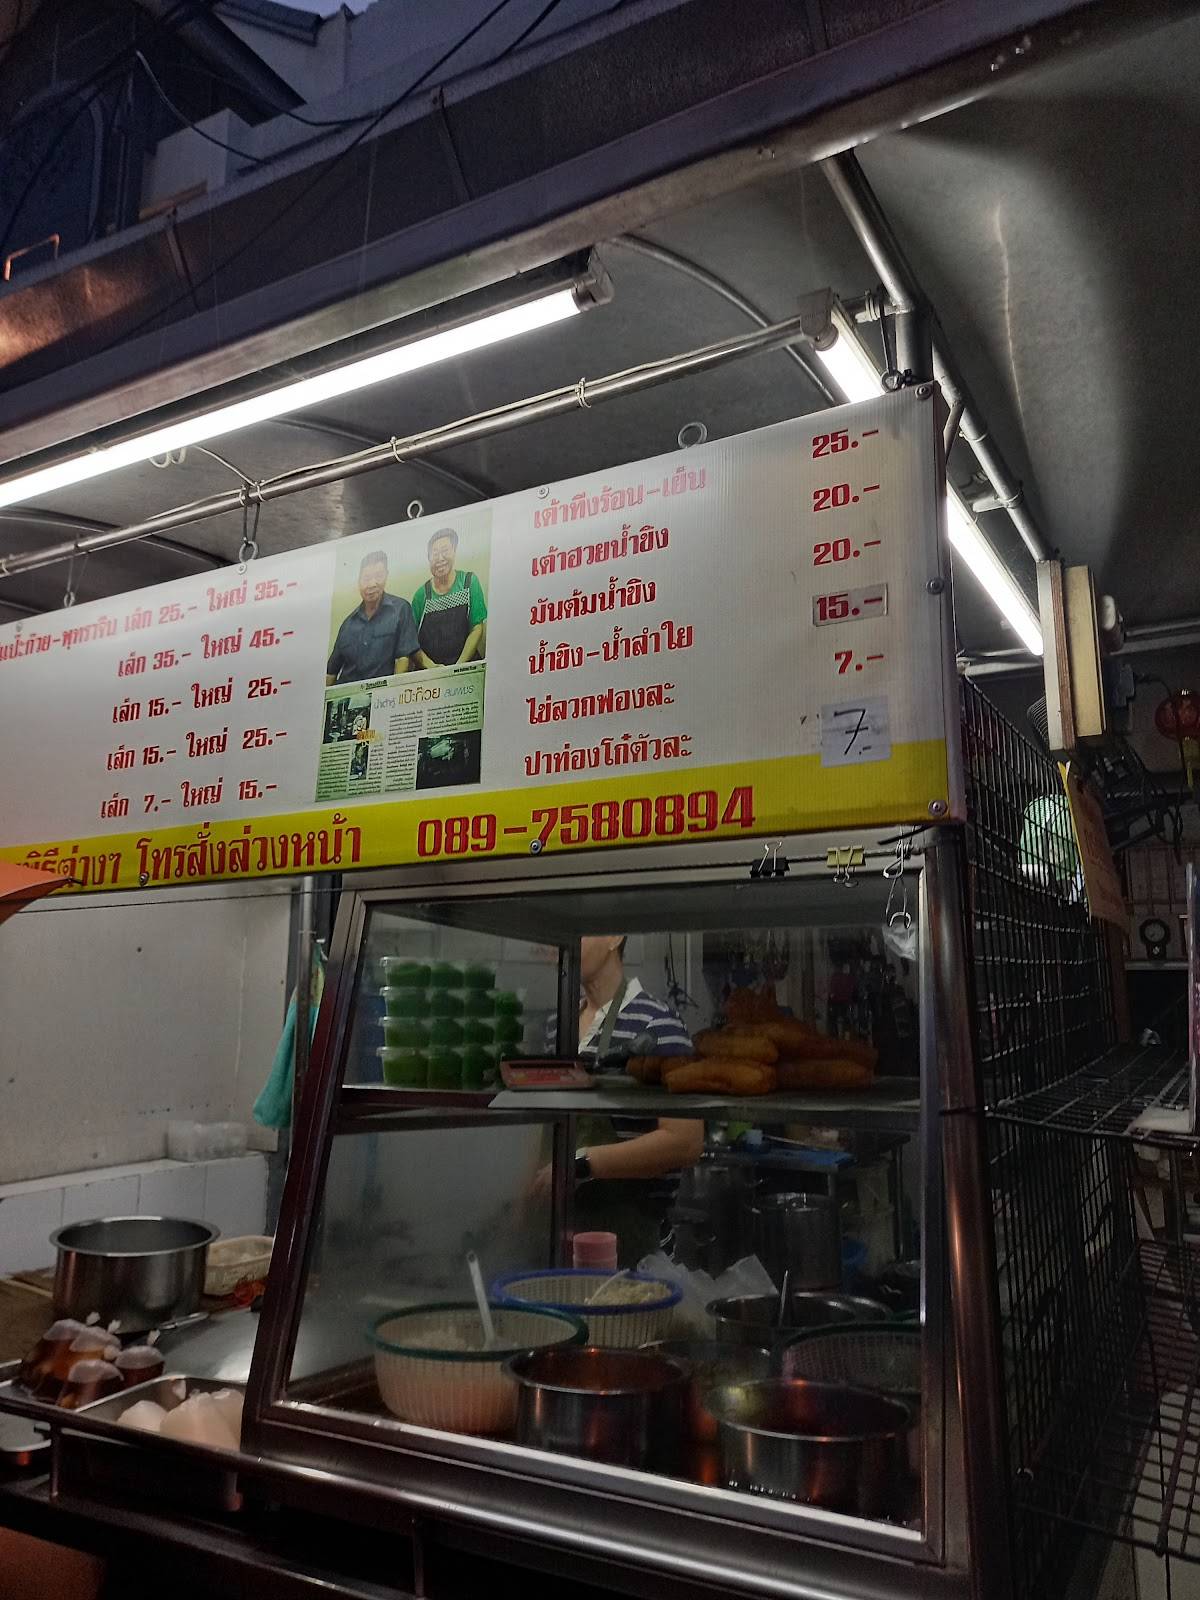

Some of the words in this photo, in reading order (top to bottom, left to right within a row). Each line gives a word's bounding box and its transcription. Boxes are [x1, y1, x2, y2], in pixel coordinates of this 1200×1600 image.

[811, 428, 880, 459] 25.-
[531, 524, 670, 577] เต้าฮวยน้ำขิง
[812, 483, 881, 512] 20.-
[529, 577, 656, 626] มันต้มน้ำขิง
[812, 538, 882, 567] 20.-
[124, 608, 152, 633] เล็ก
[158, 602, 197, 625] 25.-
[207, 581, 246, 611] ใหญ่
[254, 579, 297, 601] 35.-
[816, 593, 883, 621] 15.-
[117, 652, 146, 677] เล็ก
[152, 650, 192, 670] 35.-
[201, 628, 242, 658] ใหญ่
[249, 628, 294, 649] 45.-
[112, 698, 140, 723] เล็ก
[148, 699, 182, 716] 15.-
[191, 678, 233, 708] ใหญ่
[248, 677, 292, 698] 25.-
[526, 682, 676, 725] ไข่ลวกฟองละ
[834, 649, 884, 675] 7.-
[106, 746, 134, 770] เล็ก
[142, 746, 176, 765] 15.-
[185, 727, 228, 758] ใหญ่
[243, 728, 287, 749] 25.-
[524, 733, 692, 776] ปาท่องโก๋ตัวละ
[100, 793, 129, 818] เล็ก
[143, 794, 171, 812] 7.-
[181, 777, 223, 808] ใหญ่
[238, 779, 277, 800] 15.-
[136, 813, 361, 882] โทรสั่งล่วงหน้า
[417, 785, 756, 857] 089-7580894
